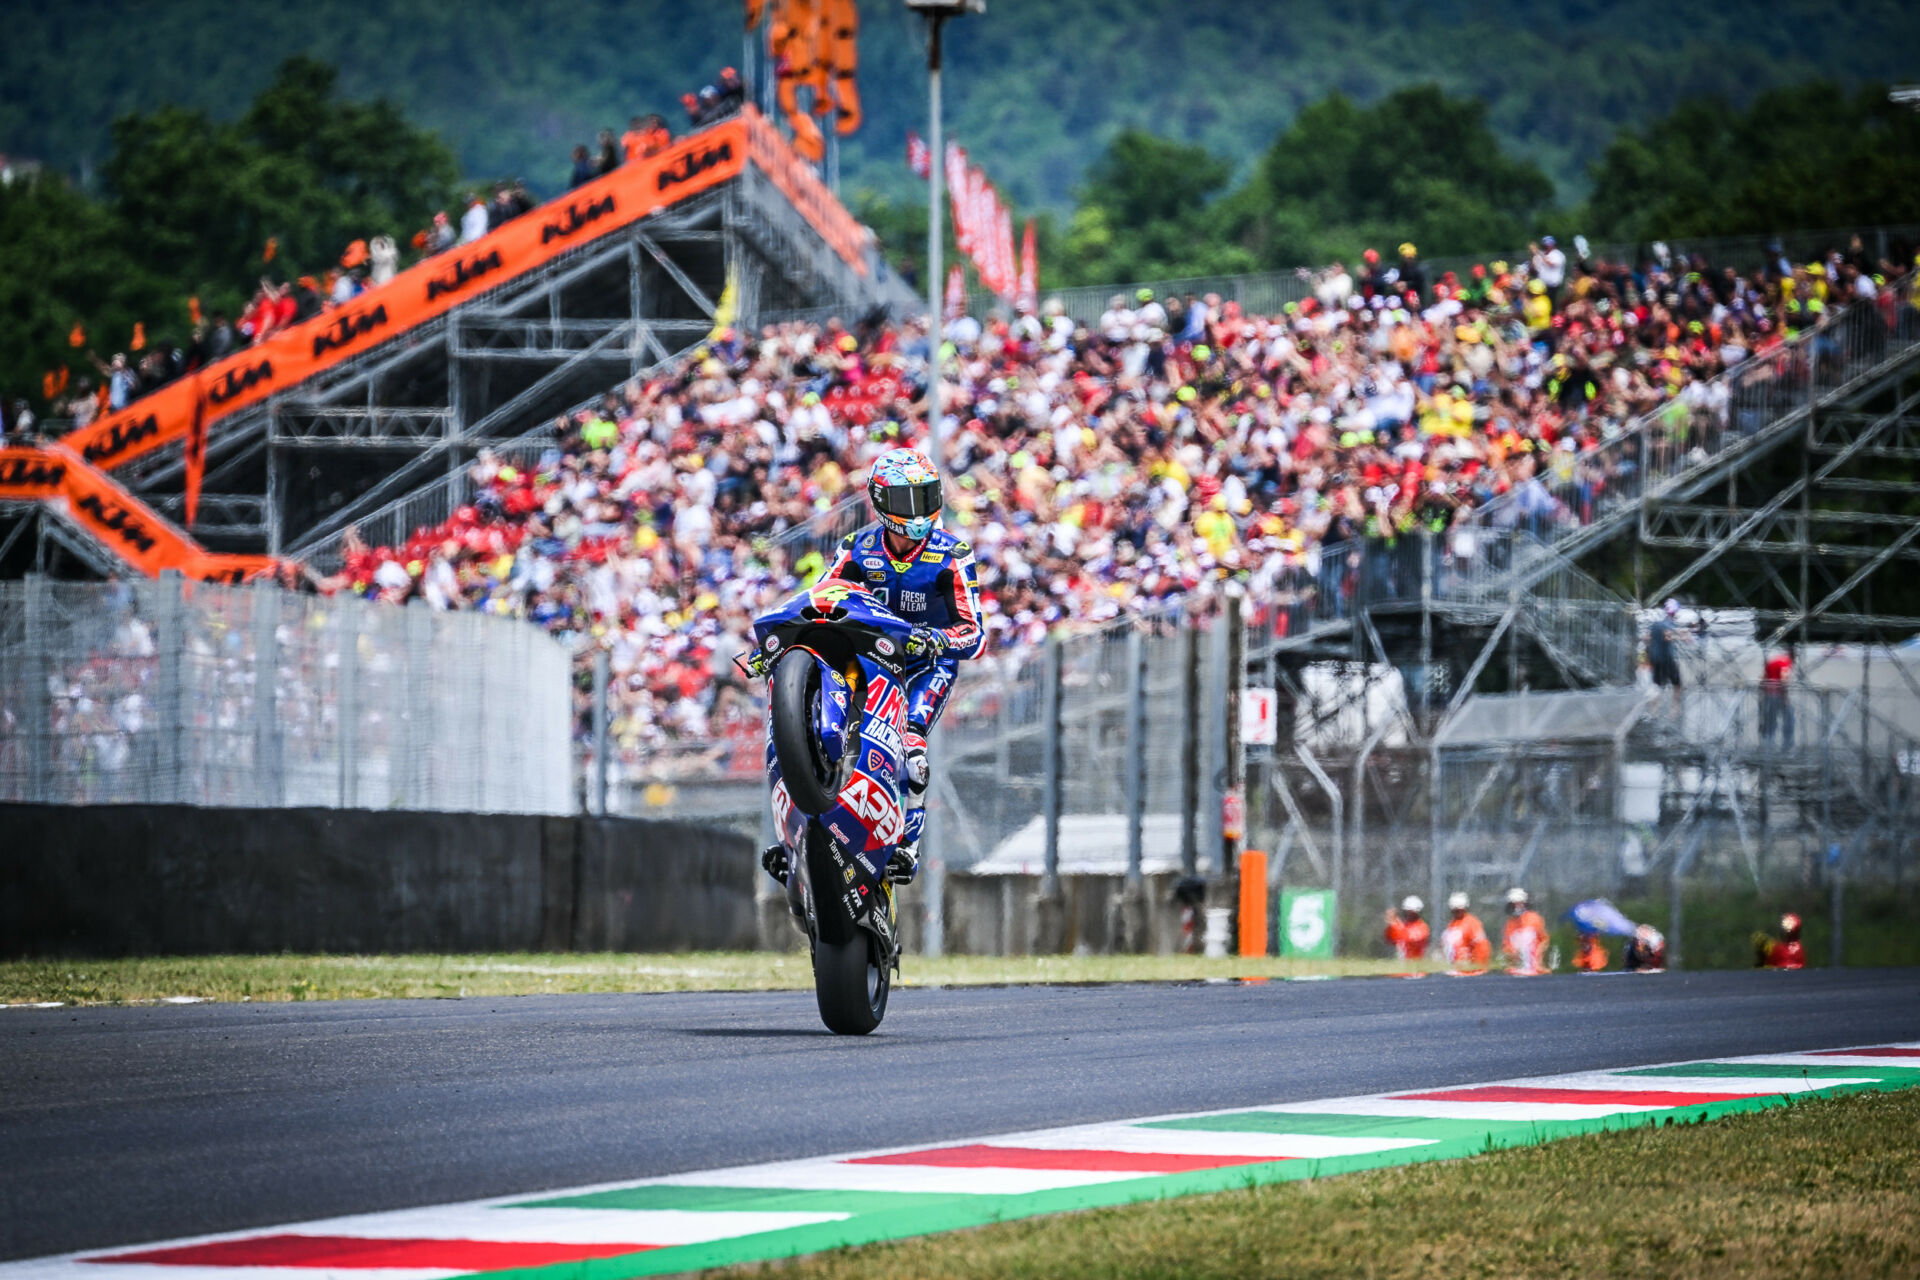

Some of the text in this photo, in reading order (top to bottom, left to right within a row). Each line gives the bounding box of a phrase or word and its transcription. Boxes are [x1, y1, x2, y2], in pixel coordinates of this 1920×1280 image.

[657, 143, 732, 191] KTM
[541, 195, 615, 244] KTM
[426, 251, 503, 301] KTM
[313, 303, 388, 357] KTM
[82, 413, 158, 461] KTM
[78, 494, 156, 552] KTM
[922, 553, 940, 561] Hertz
[901, 590, 926, 602] FRESH
[907, 602, 927, 612] LEAN
[767, 637, 777, 649] BELL
[867, 651, 894, 670] MACNA
[878, 640, 892, 653] BELL
[829, 838, 845, 867] Targus
[1288, 894, 1325, 951] 5
